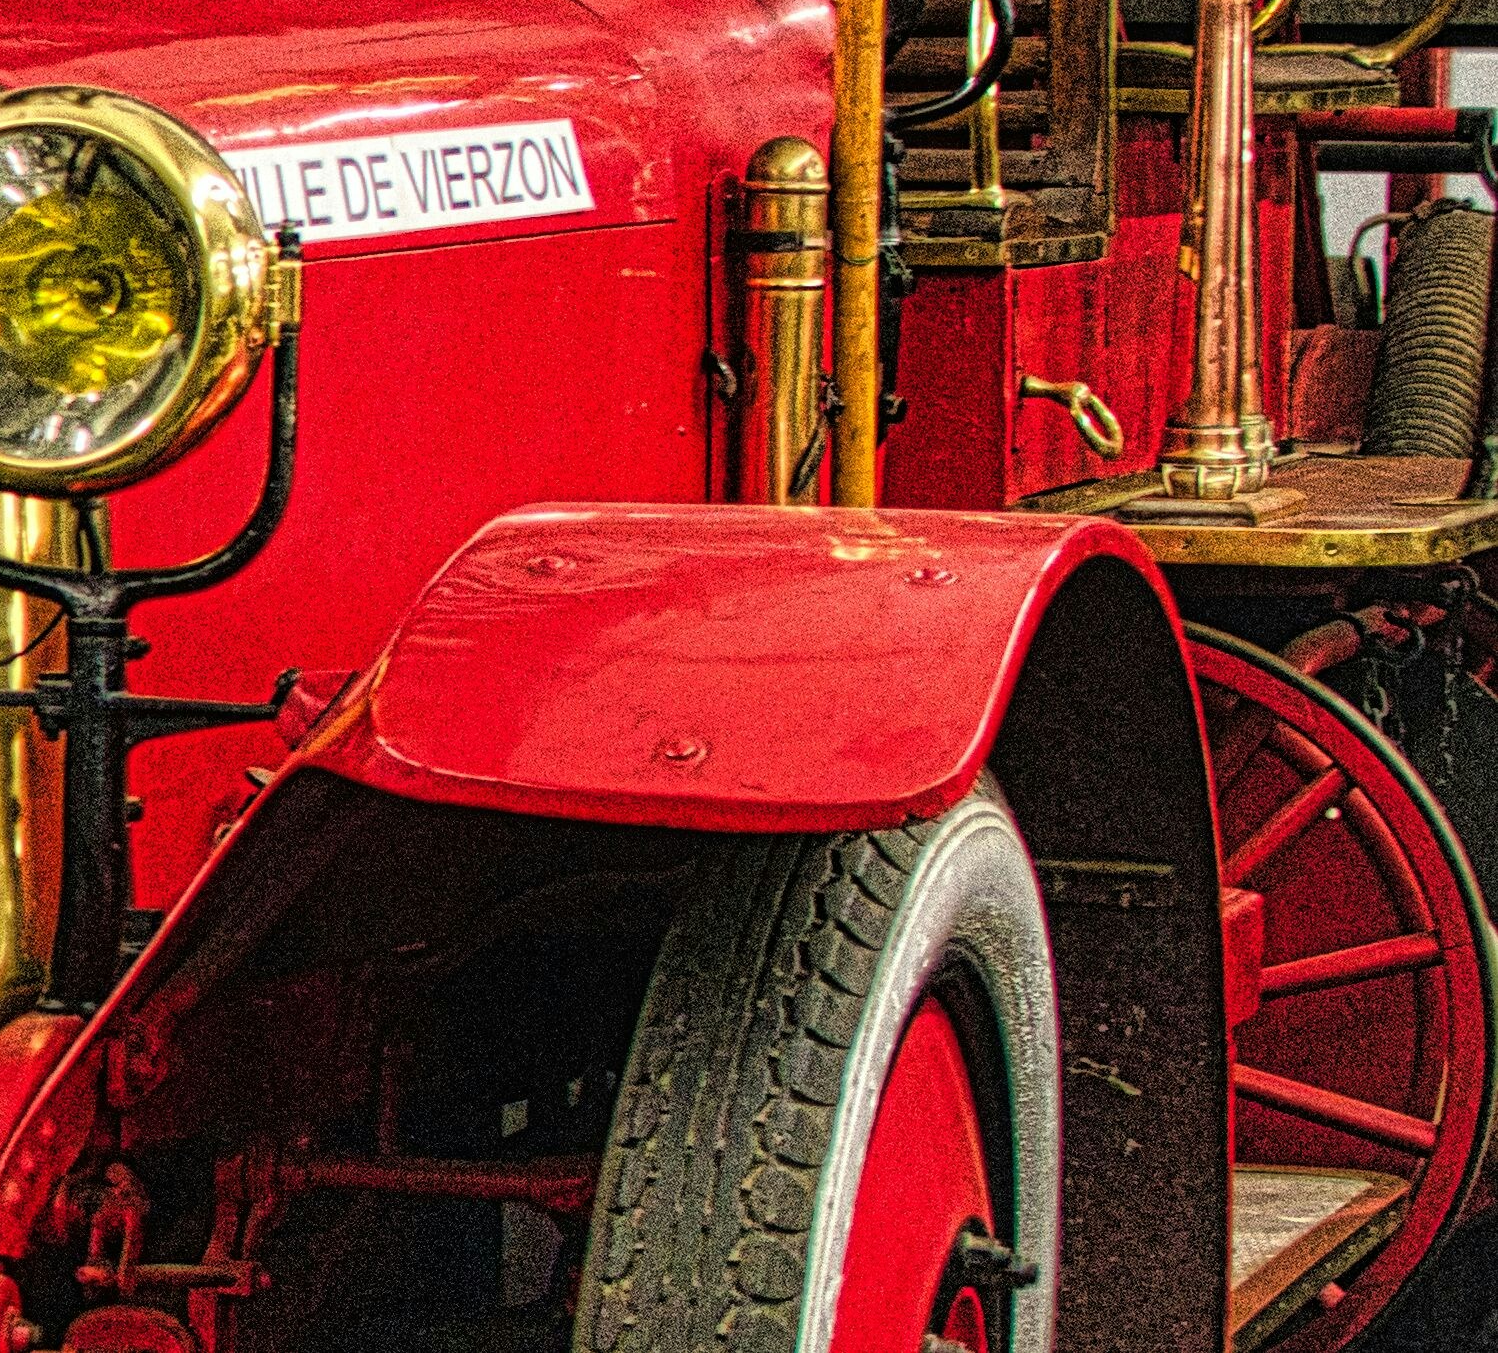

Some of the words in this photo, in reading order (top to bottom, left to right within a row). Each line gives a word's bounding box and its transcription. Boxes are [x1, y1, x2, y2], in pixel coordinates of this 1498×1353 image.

[233, 161, 332, 228] ILLE
[337, 153, 397, 222] DE
[401, 136, 581, 212] VIERZON
